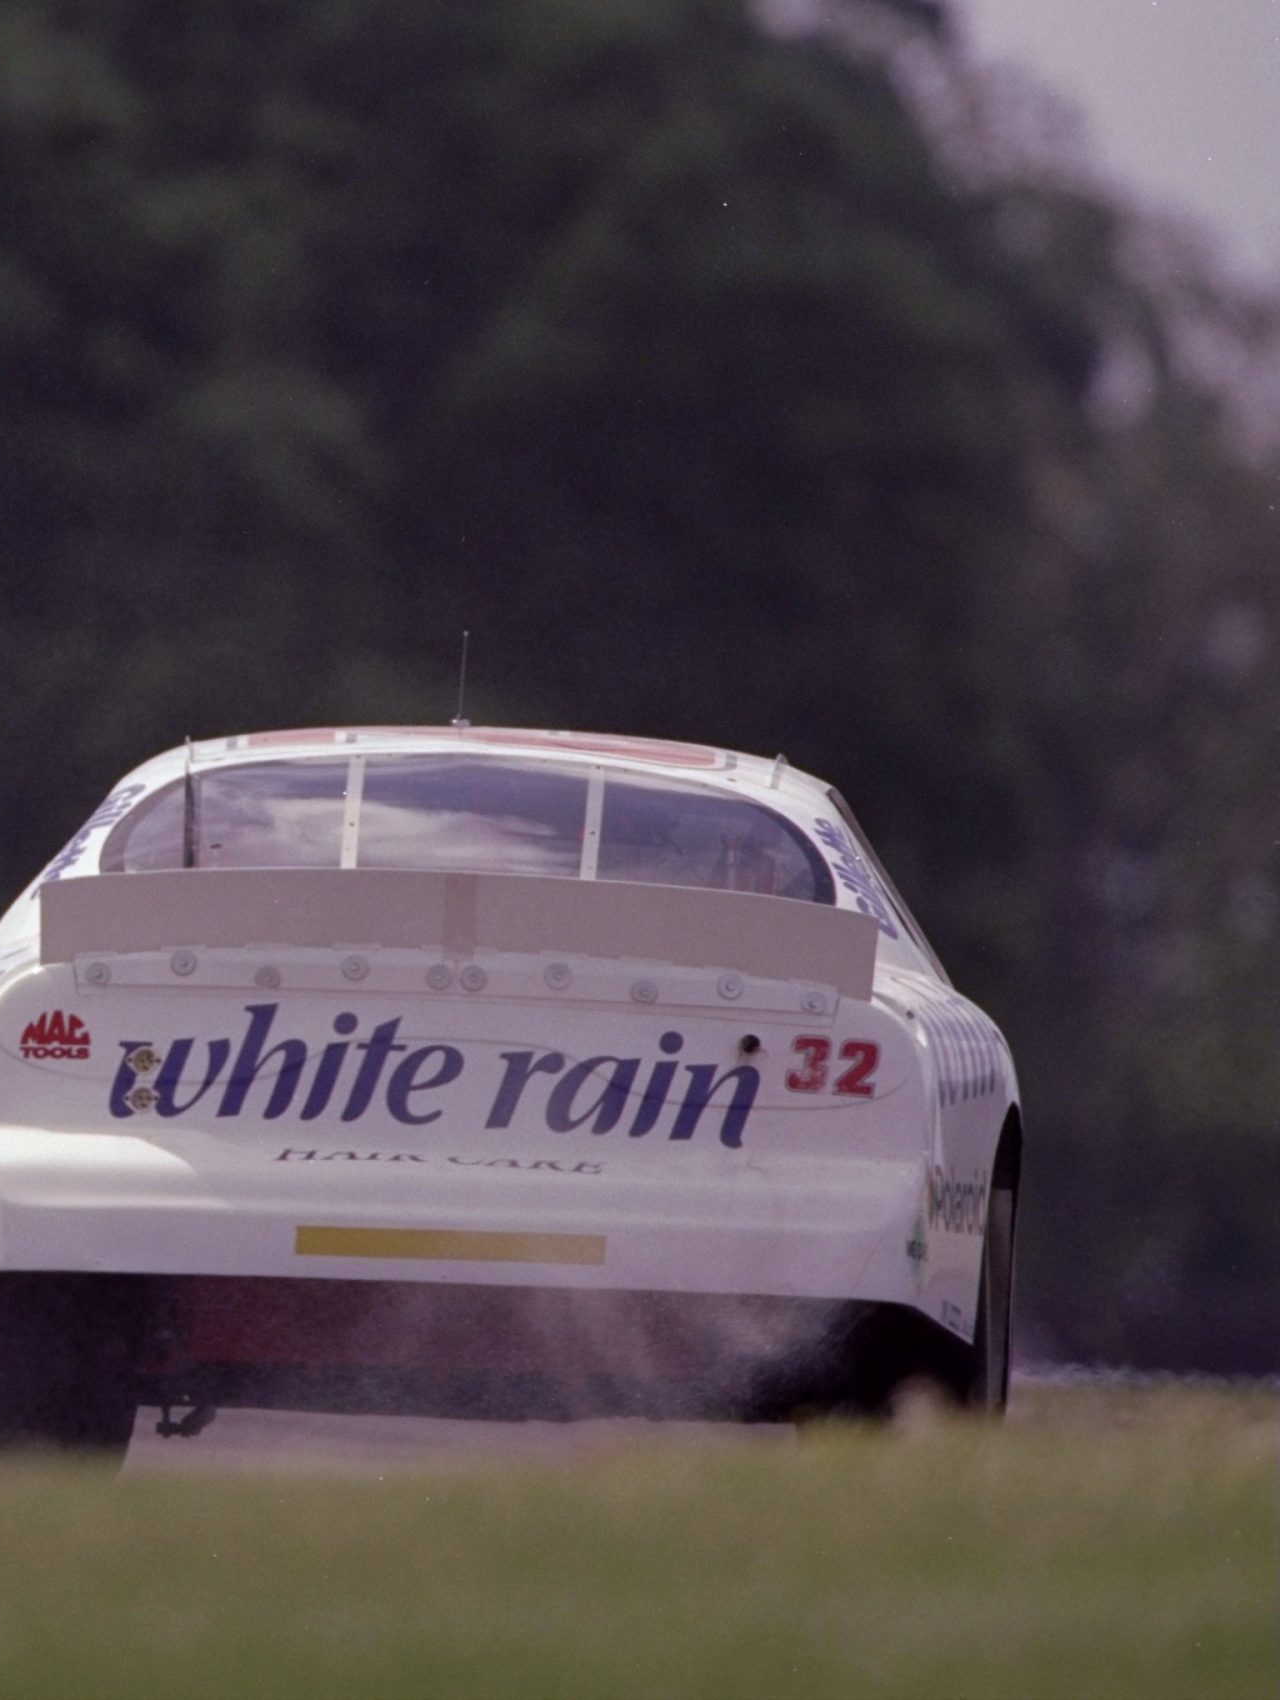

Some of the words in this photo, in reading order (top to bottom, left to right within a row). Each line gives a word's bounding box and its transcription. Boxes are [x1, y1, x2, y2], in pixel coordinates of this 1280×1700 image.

[19, 1046, 90, 1060] TOOLS
[20, 1009, 90, 1046] MAC
[108, 1002, 464, 1126] white
[485, 1030, 761, 1150] rain
[784, 1033, 882, 1099] 32
[274, 1148, 427, 1163] HAIR
[447, 1155, 606, 1175] CARE
[933, 1164, 987, 1237] Polaroid
